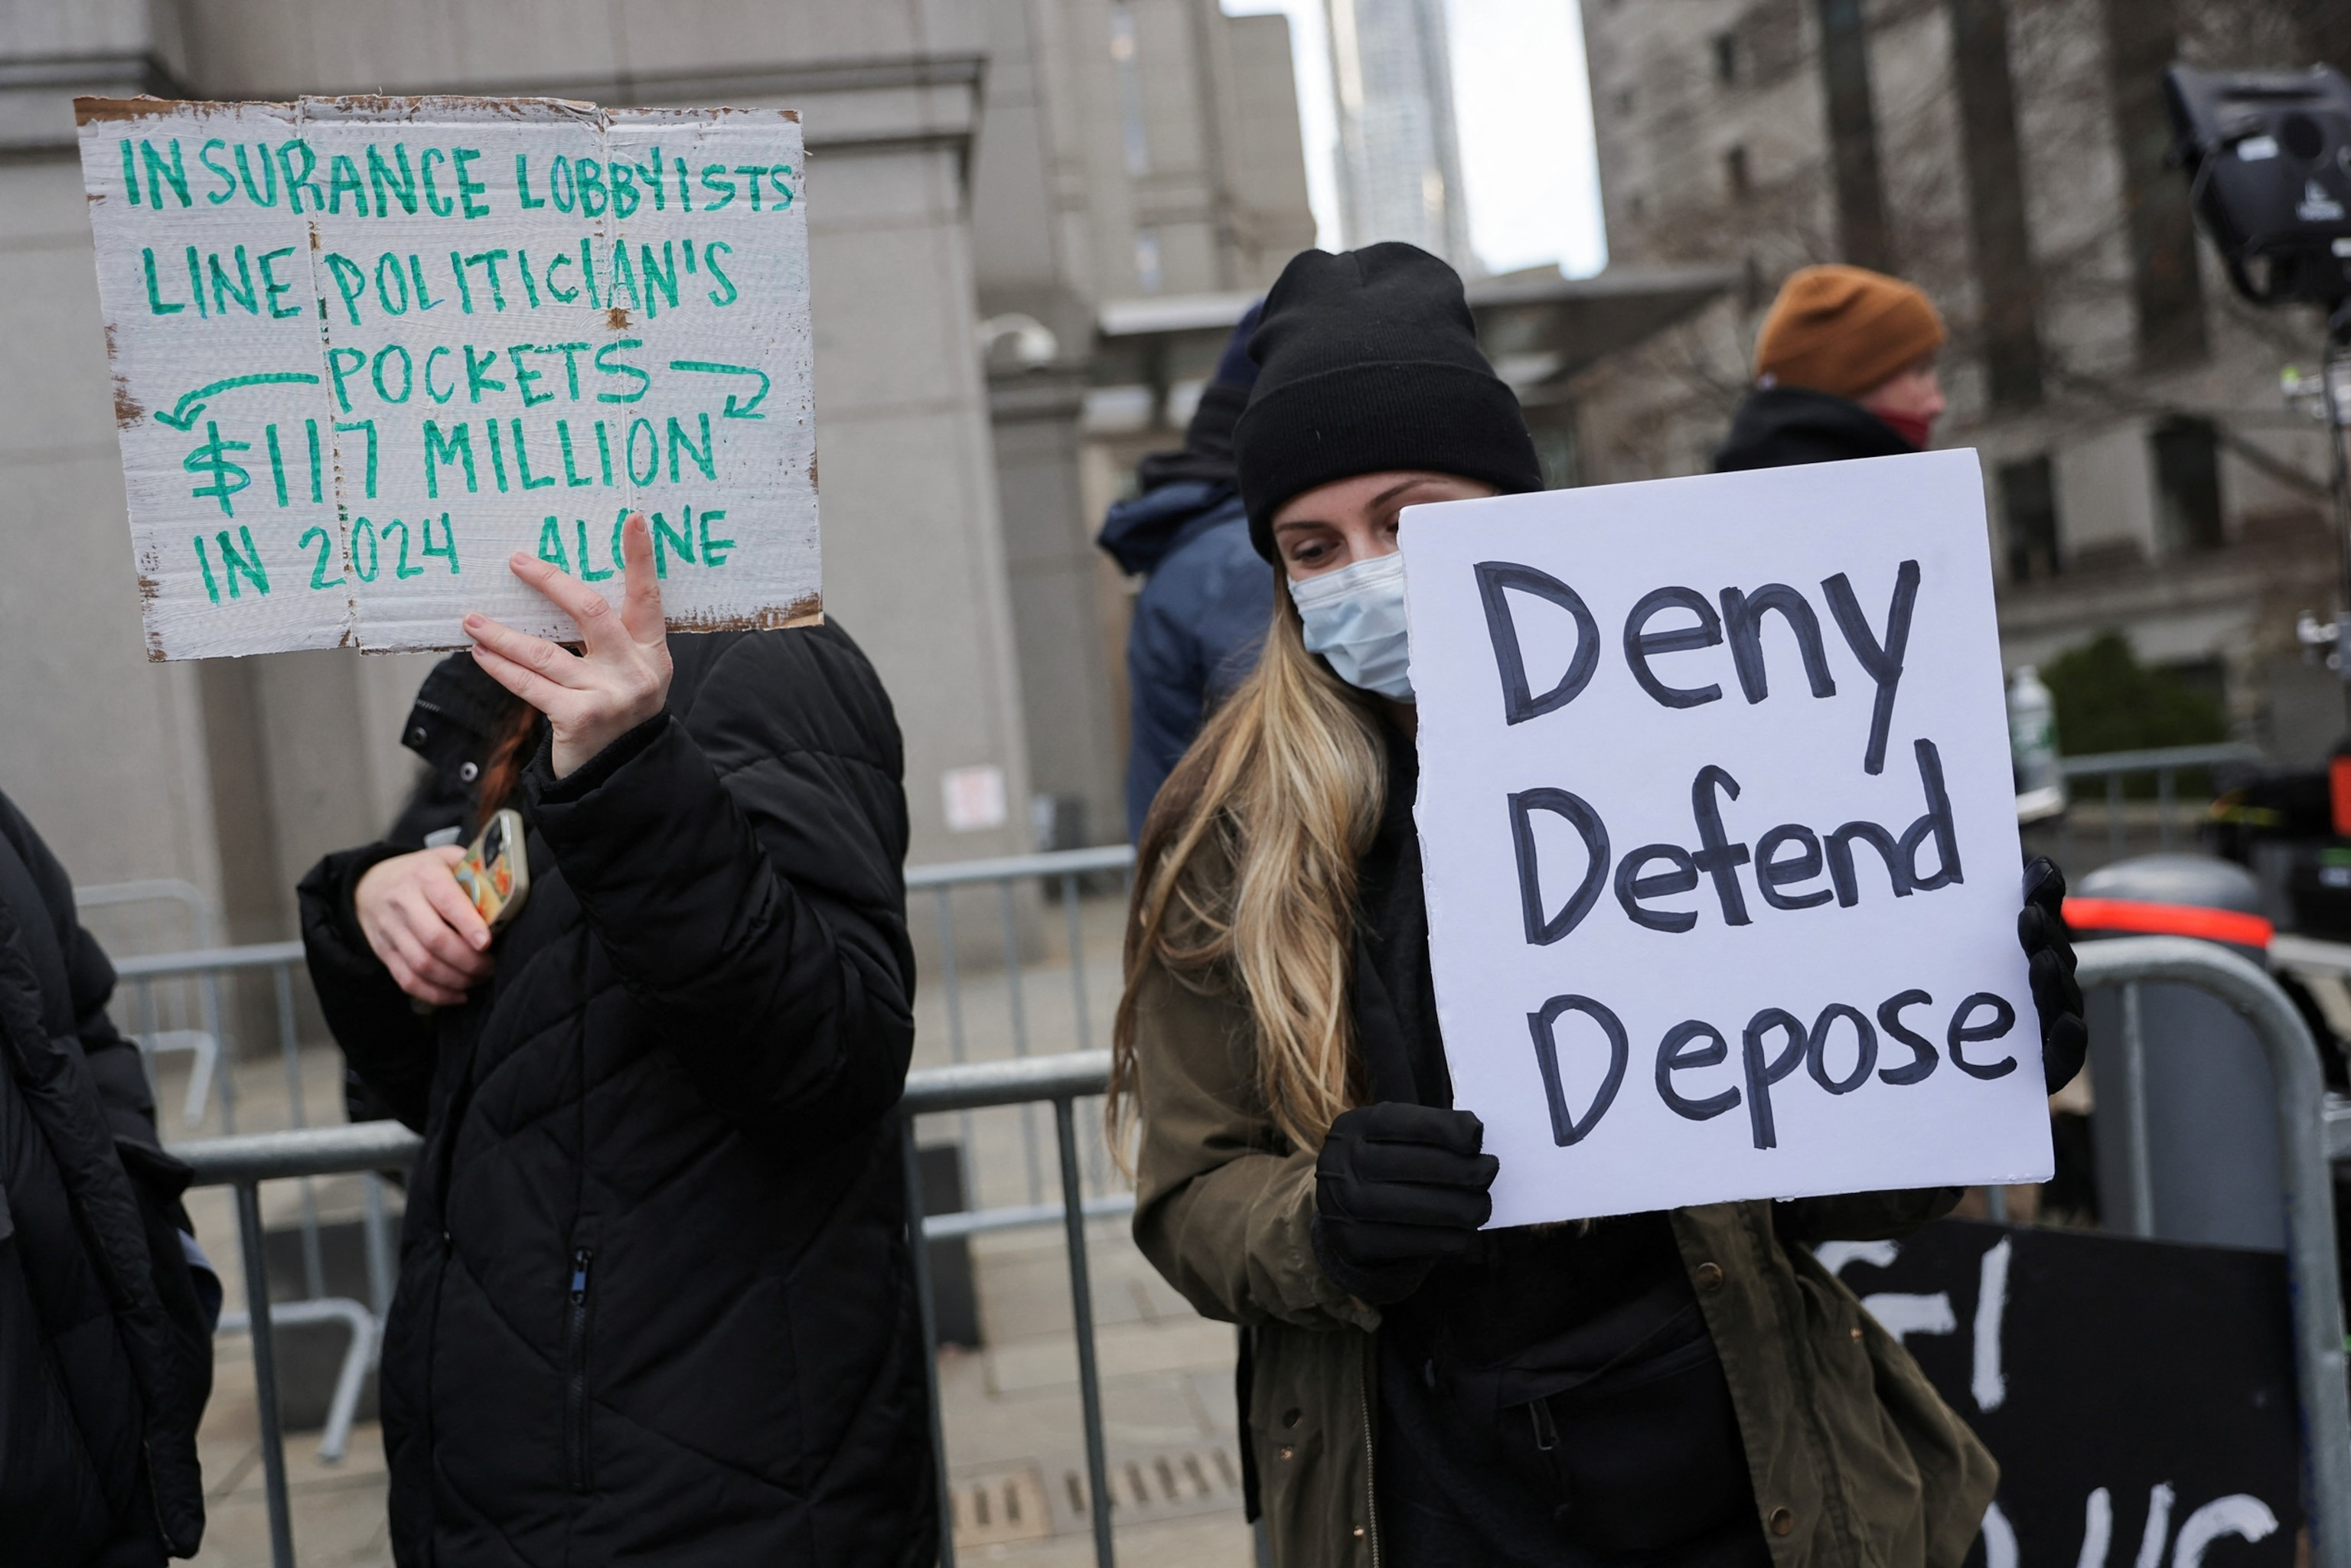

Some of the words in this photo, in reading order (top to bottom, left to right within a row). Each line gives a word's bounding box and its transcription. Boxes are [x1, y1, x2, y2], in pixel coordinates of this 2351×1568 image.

[120, 138, 490, 220] INSURANCE
[516, 146, 794, 220] LOBBYISTS
[142, 244, 302, 319] LINE
[324, 237, 738, 326] POLITICIAN'S
[328, 338, 651, 414] POCKETS
[182, 419, 378, 518] $117
[422, 412, 717, 499] MILLION
[194, 525, 270, 604] IN
[298, 512, 460, 591] 2024
[1472, 559, 1921, 776] Deny
[1506, 738, 1965, 947] Defend
[1526, 989, 2018, 1150] Depose
